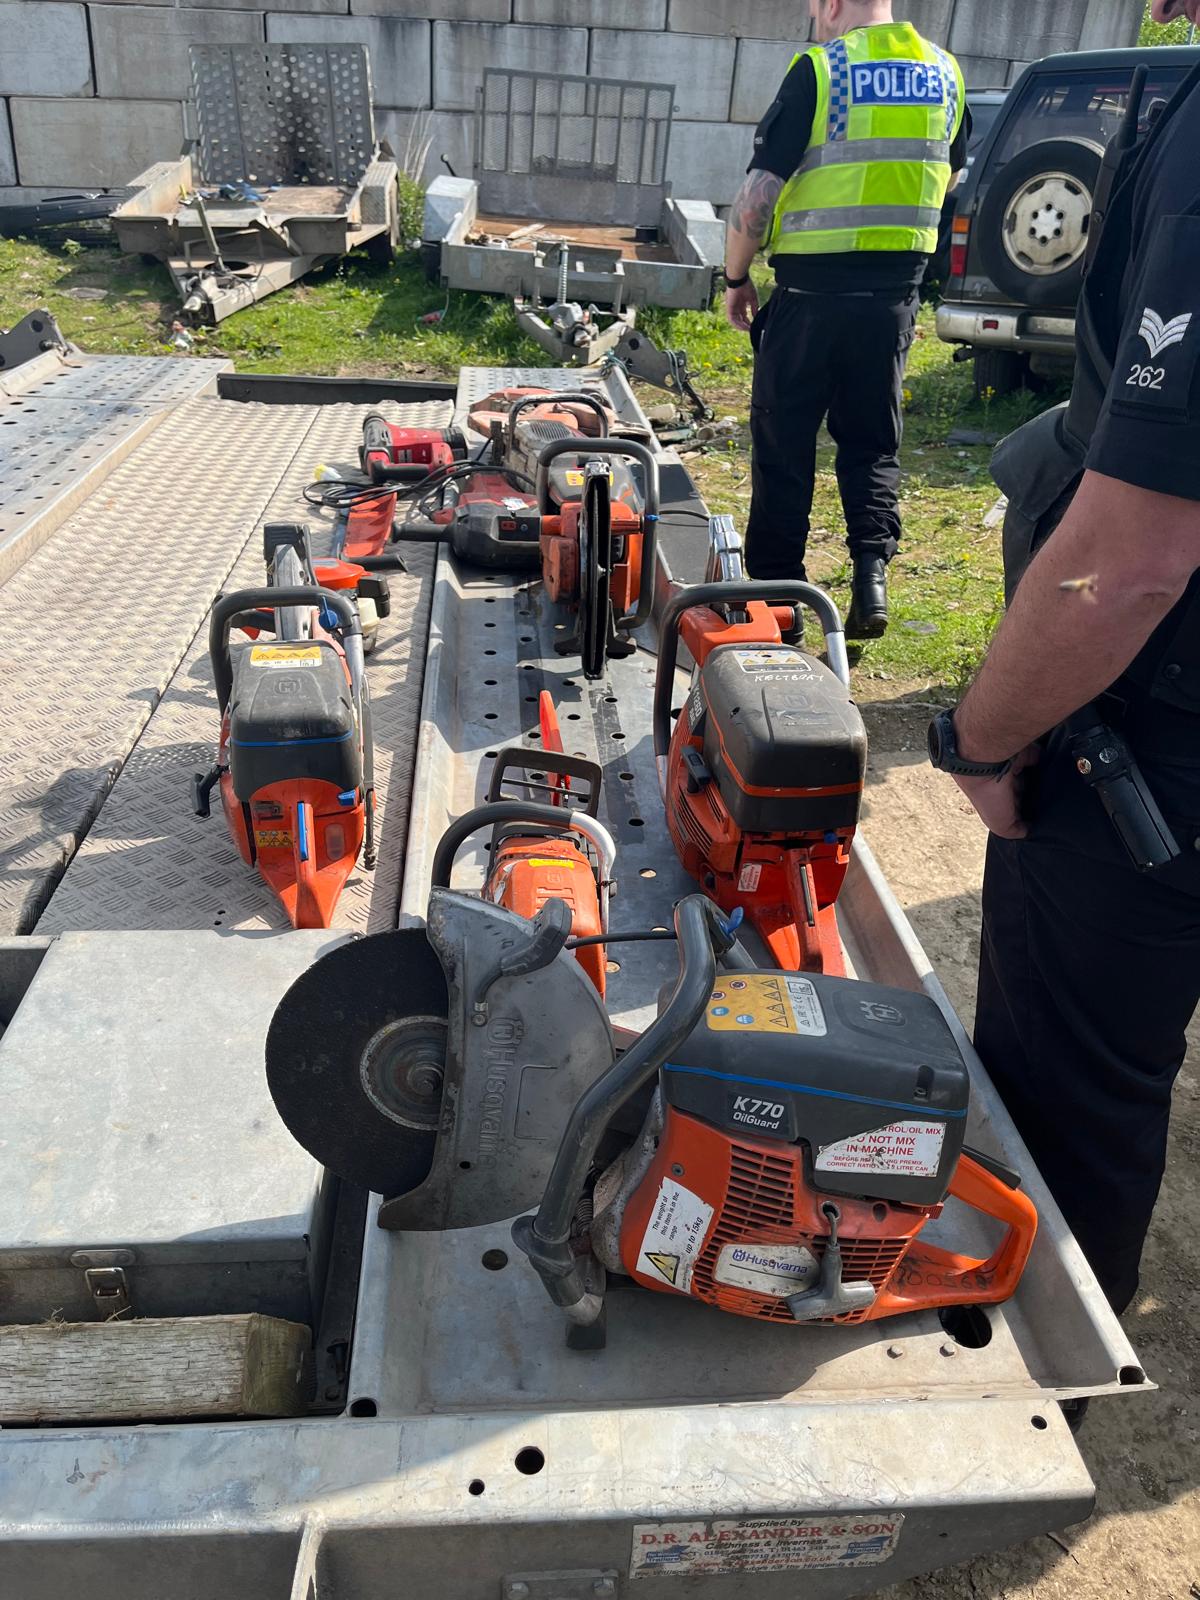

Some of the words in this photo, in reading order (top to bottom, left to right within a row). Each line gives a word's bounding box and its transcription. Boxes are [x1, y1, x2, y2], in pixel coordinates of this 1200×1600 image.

[854, 67, 940, 98] POLICE
[1126, 363, 1166, 390] 262
[733, 1112, 780, 1129] OilGuard
[925, 1127, 942, 1135] MIX
[868, 1135, 893, 1144] NOT
[895, 1136, 916, 1146] MIX
[846, 1144, 859, 1153] IN
[861, 1145, 914, 1156] MACHINE
[652, 1221, 660, 1231] The
[657, 1202, 668, 1220] weight
[660, 1226, 668, 1236] this
[664, 1213, 673, 1225] item
[672, 1191, 680, 1200] the
[668, 1225, 678, 1241] range
[691, 1217, 704, 1236] 15kg
[688, 1234, 696, 1243] to
[685, 1242, 693, 1254] up
[745, 1253, 808, 1274] Husqvarna
[737, 1519, 787, 1529] Supplied
[790, 1519, 805, 1527] by
[641, 1533, 682, 1545] D.R.
[687, 1526, 822, 1543] ALEXANDER
[828, 1525, 844, 1536] &
[851, 1523, 896, 1535] SON
[775, 1538, 828, 1547] Inverness
